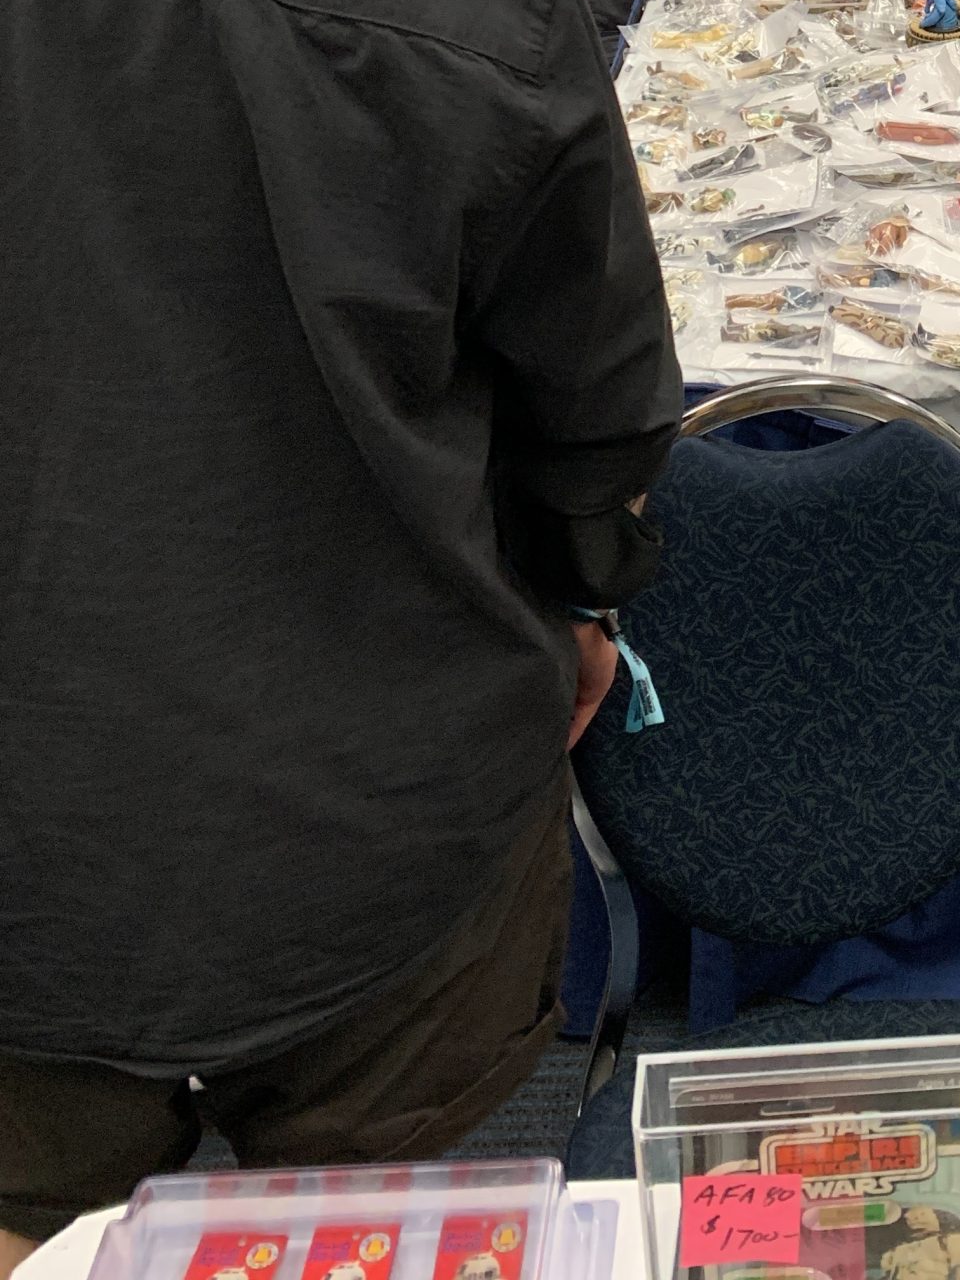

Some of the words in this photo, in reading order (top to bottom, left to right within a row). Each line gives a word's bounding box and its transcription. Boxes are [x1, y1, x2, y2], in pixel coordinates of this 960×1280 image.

[810, 1113, 884, 1135] STAR
[693, 1184, 755, 1207] AFA
[803, 1177, 895, 1201] WARS
